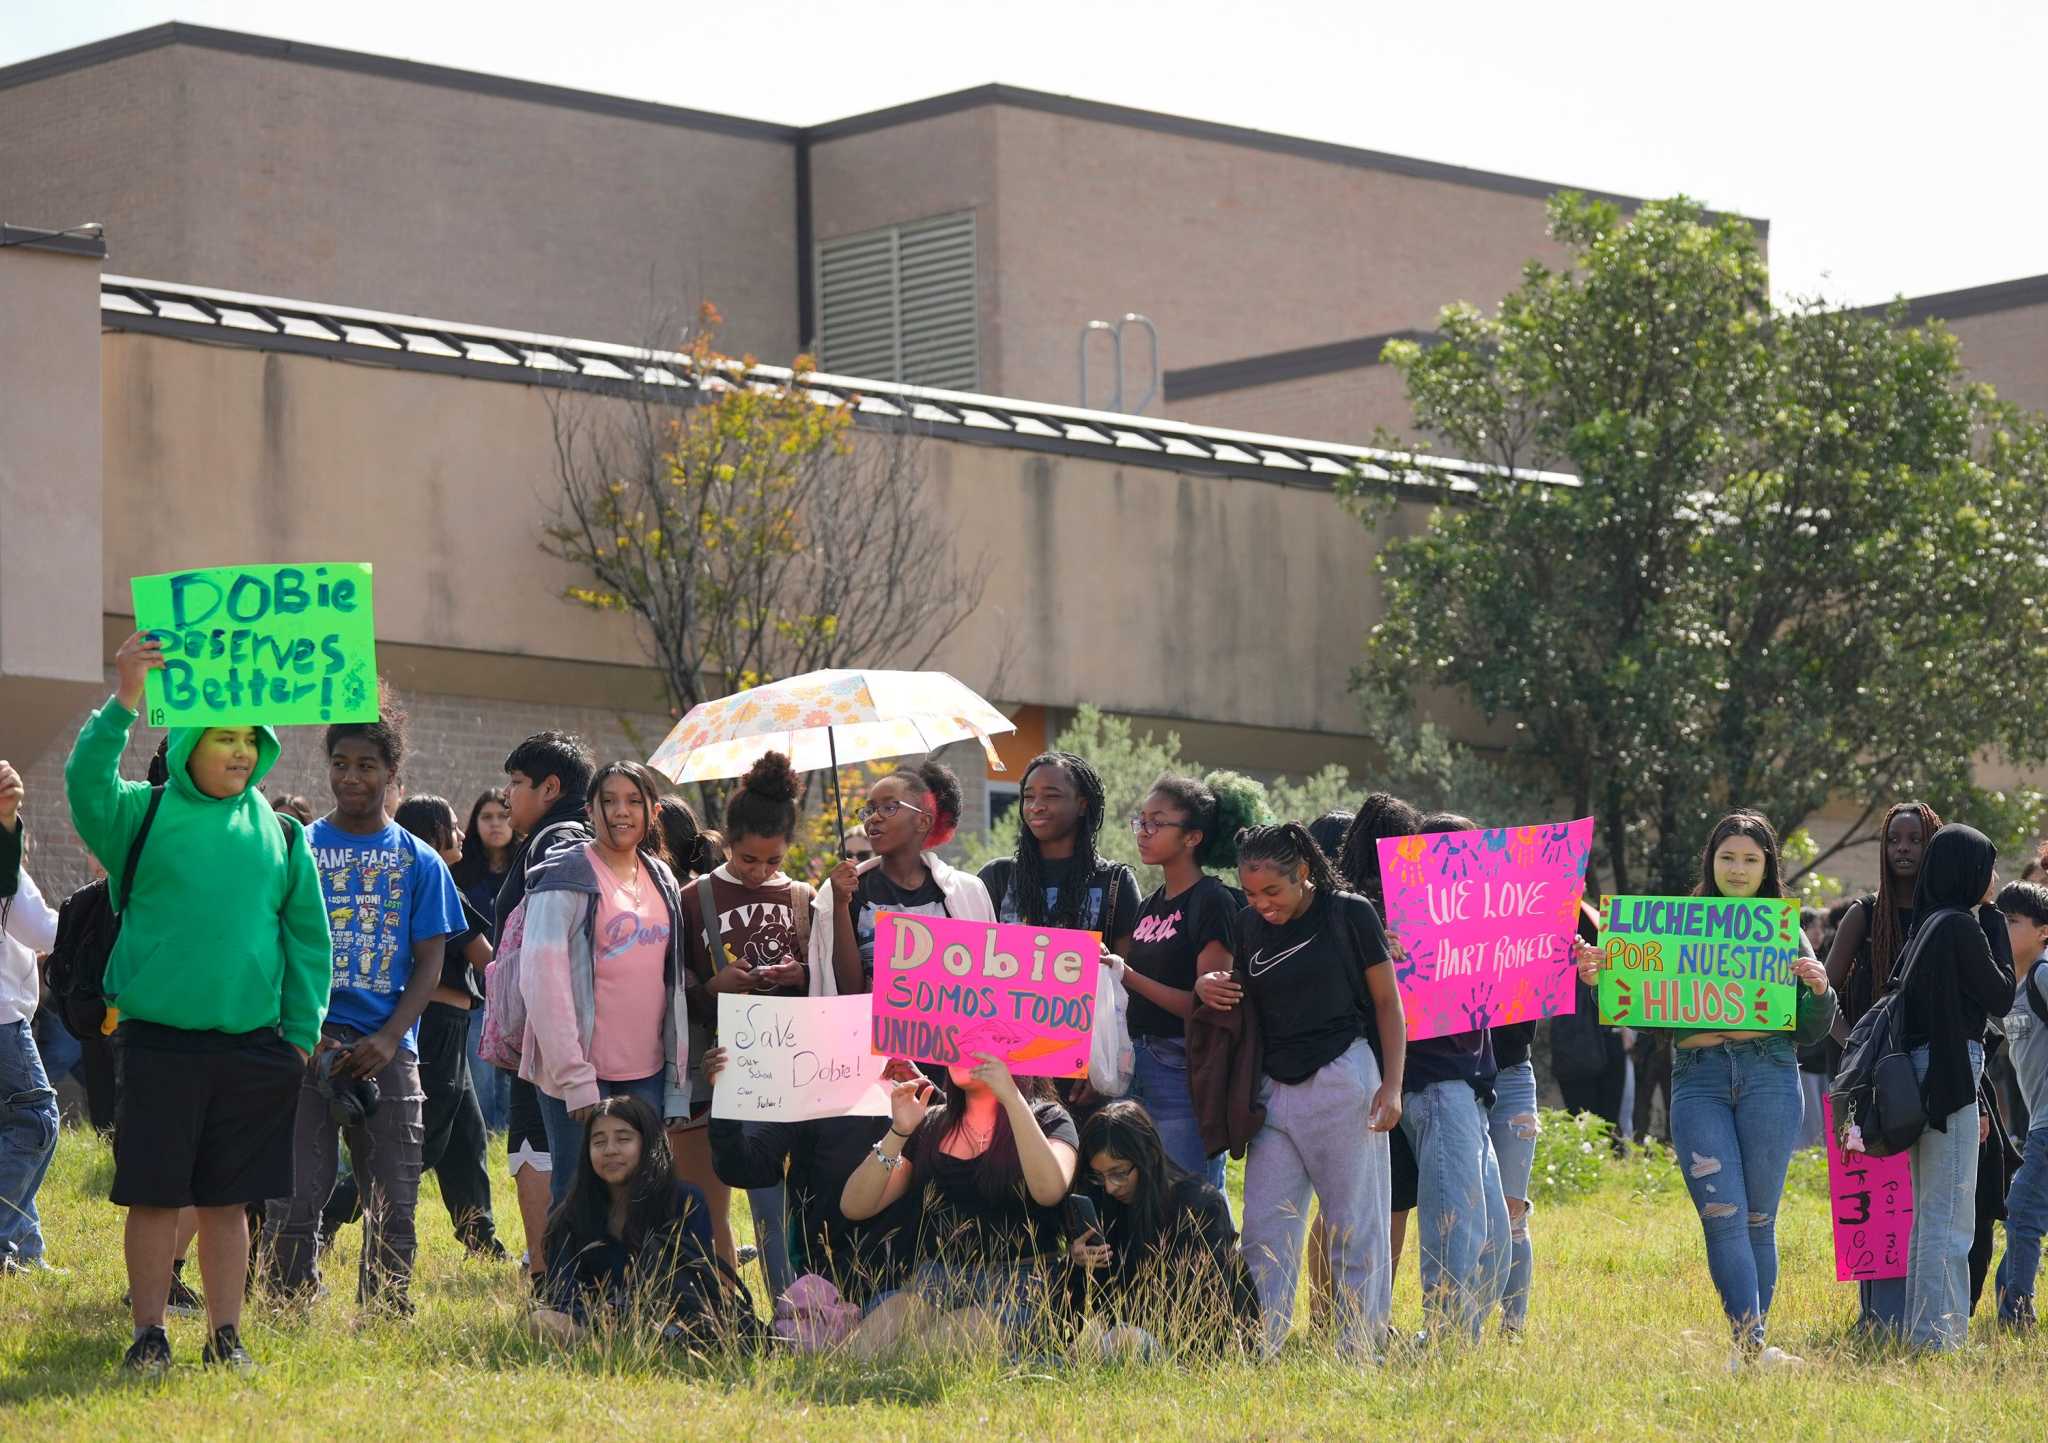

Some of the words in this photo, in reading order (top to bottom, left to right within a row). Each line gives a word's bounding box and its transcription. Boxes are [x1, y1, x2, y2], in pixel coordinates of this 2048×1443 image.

[151, 708, 165, 726] 18
[1426, 880, 1474, 925] WE
[1483, 881, 1549, 918] LOVE
[1608, 899, 1774, 942] LUCHEMOS
[890, 917, 1083, 984] Dobie
[1435, 938, 1490, 982] HART
[1605, 937, 1663, 971] POR
[1677, 944, 1798, 987] NUESTROS
[887, 975, 997, 1019] SOMOS
[1008, 990, 1095, 1033] TODOS
[1643, 980, 1746, 1024] HIJOS
[1783, 1013, 1794, 1028] 2
[872, 1014, 961, 1064] UNIDOS
